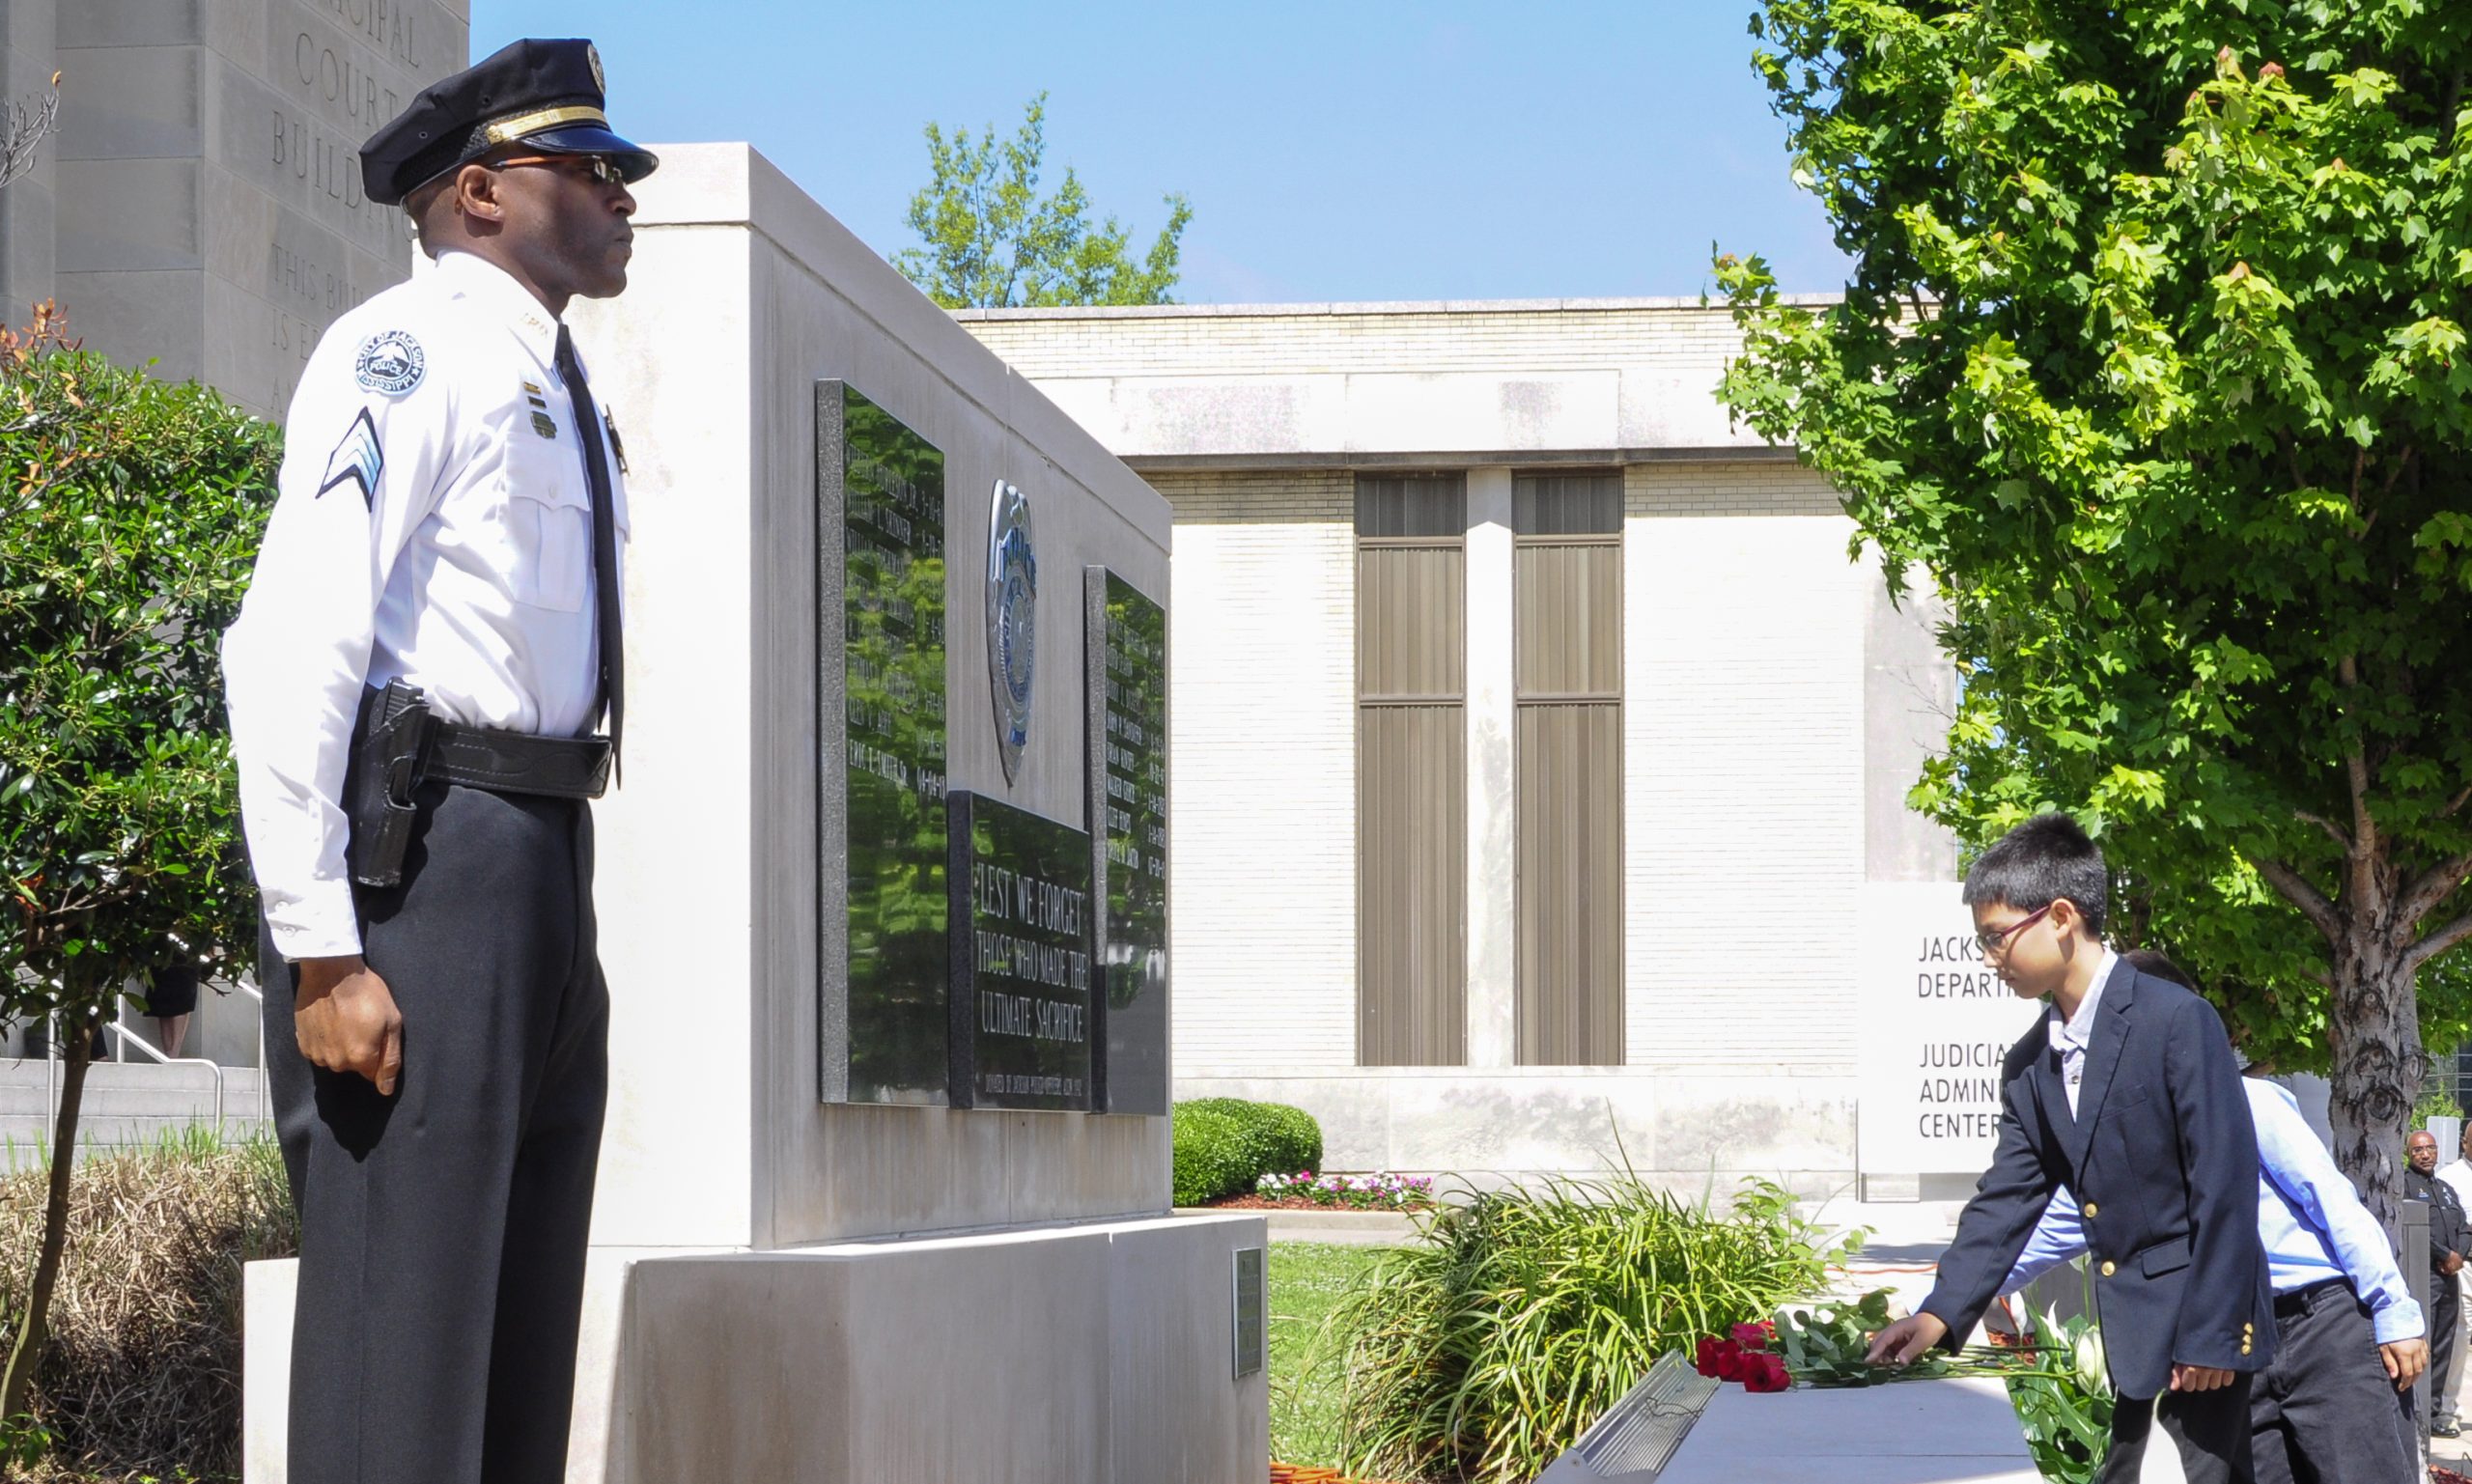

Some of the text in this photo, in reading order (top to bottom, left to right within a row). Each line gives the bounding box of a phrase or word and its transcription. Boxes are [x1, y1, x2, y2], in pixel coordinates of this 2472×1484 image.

[295, 32, 398, 131] COURT
[271, 242, 318, 301] THIS
[358, 374, 416, 391] ISSISSIPPI
[369, 359, 403, 376] POLICE
[1016, 873, 1034, 925] WE
[976, 930, 1086, 991] THOSE WHO MADE THE
[981, 990, 1082, 1042] ULTIMATE SACRIFICE
[1919, 1113, 2001, 1138] CENTER
